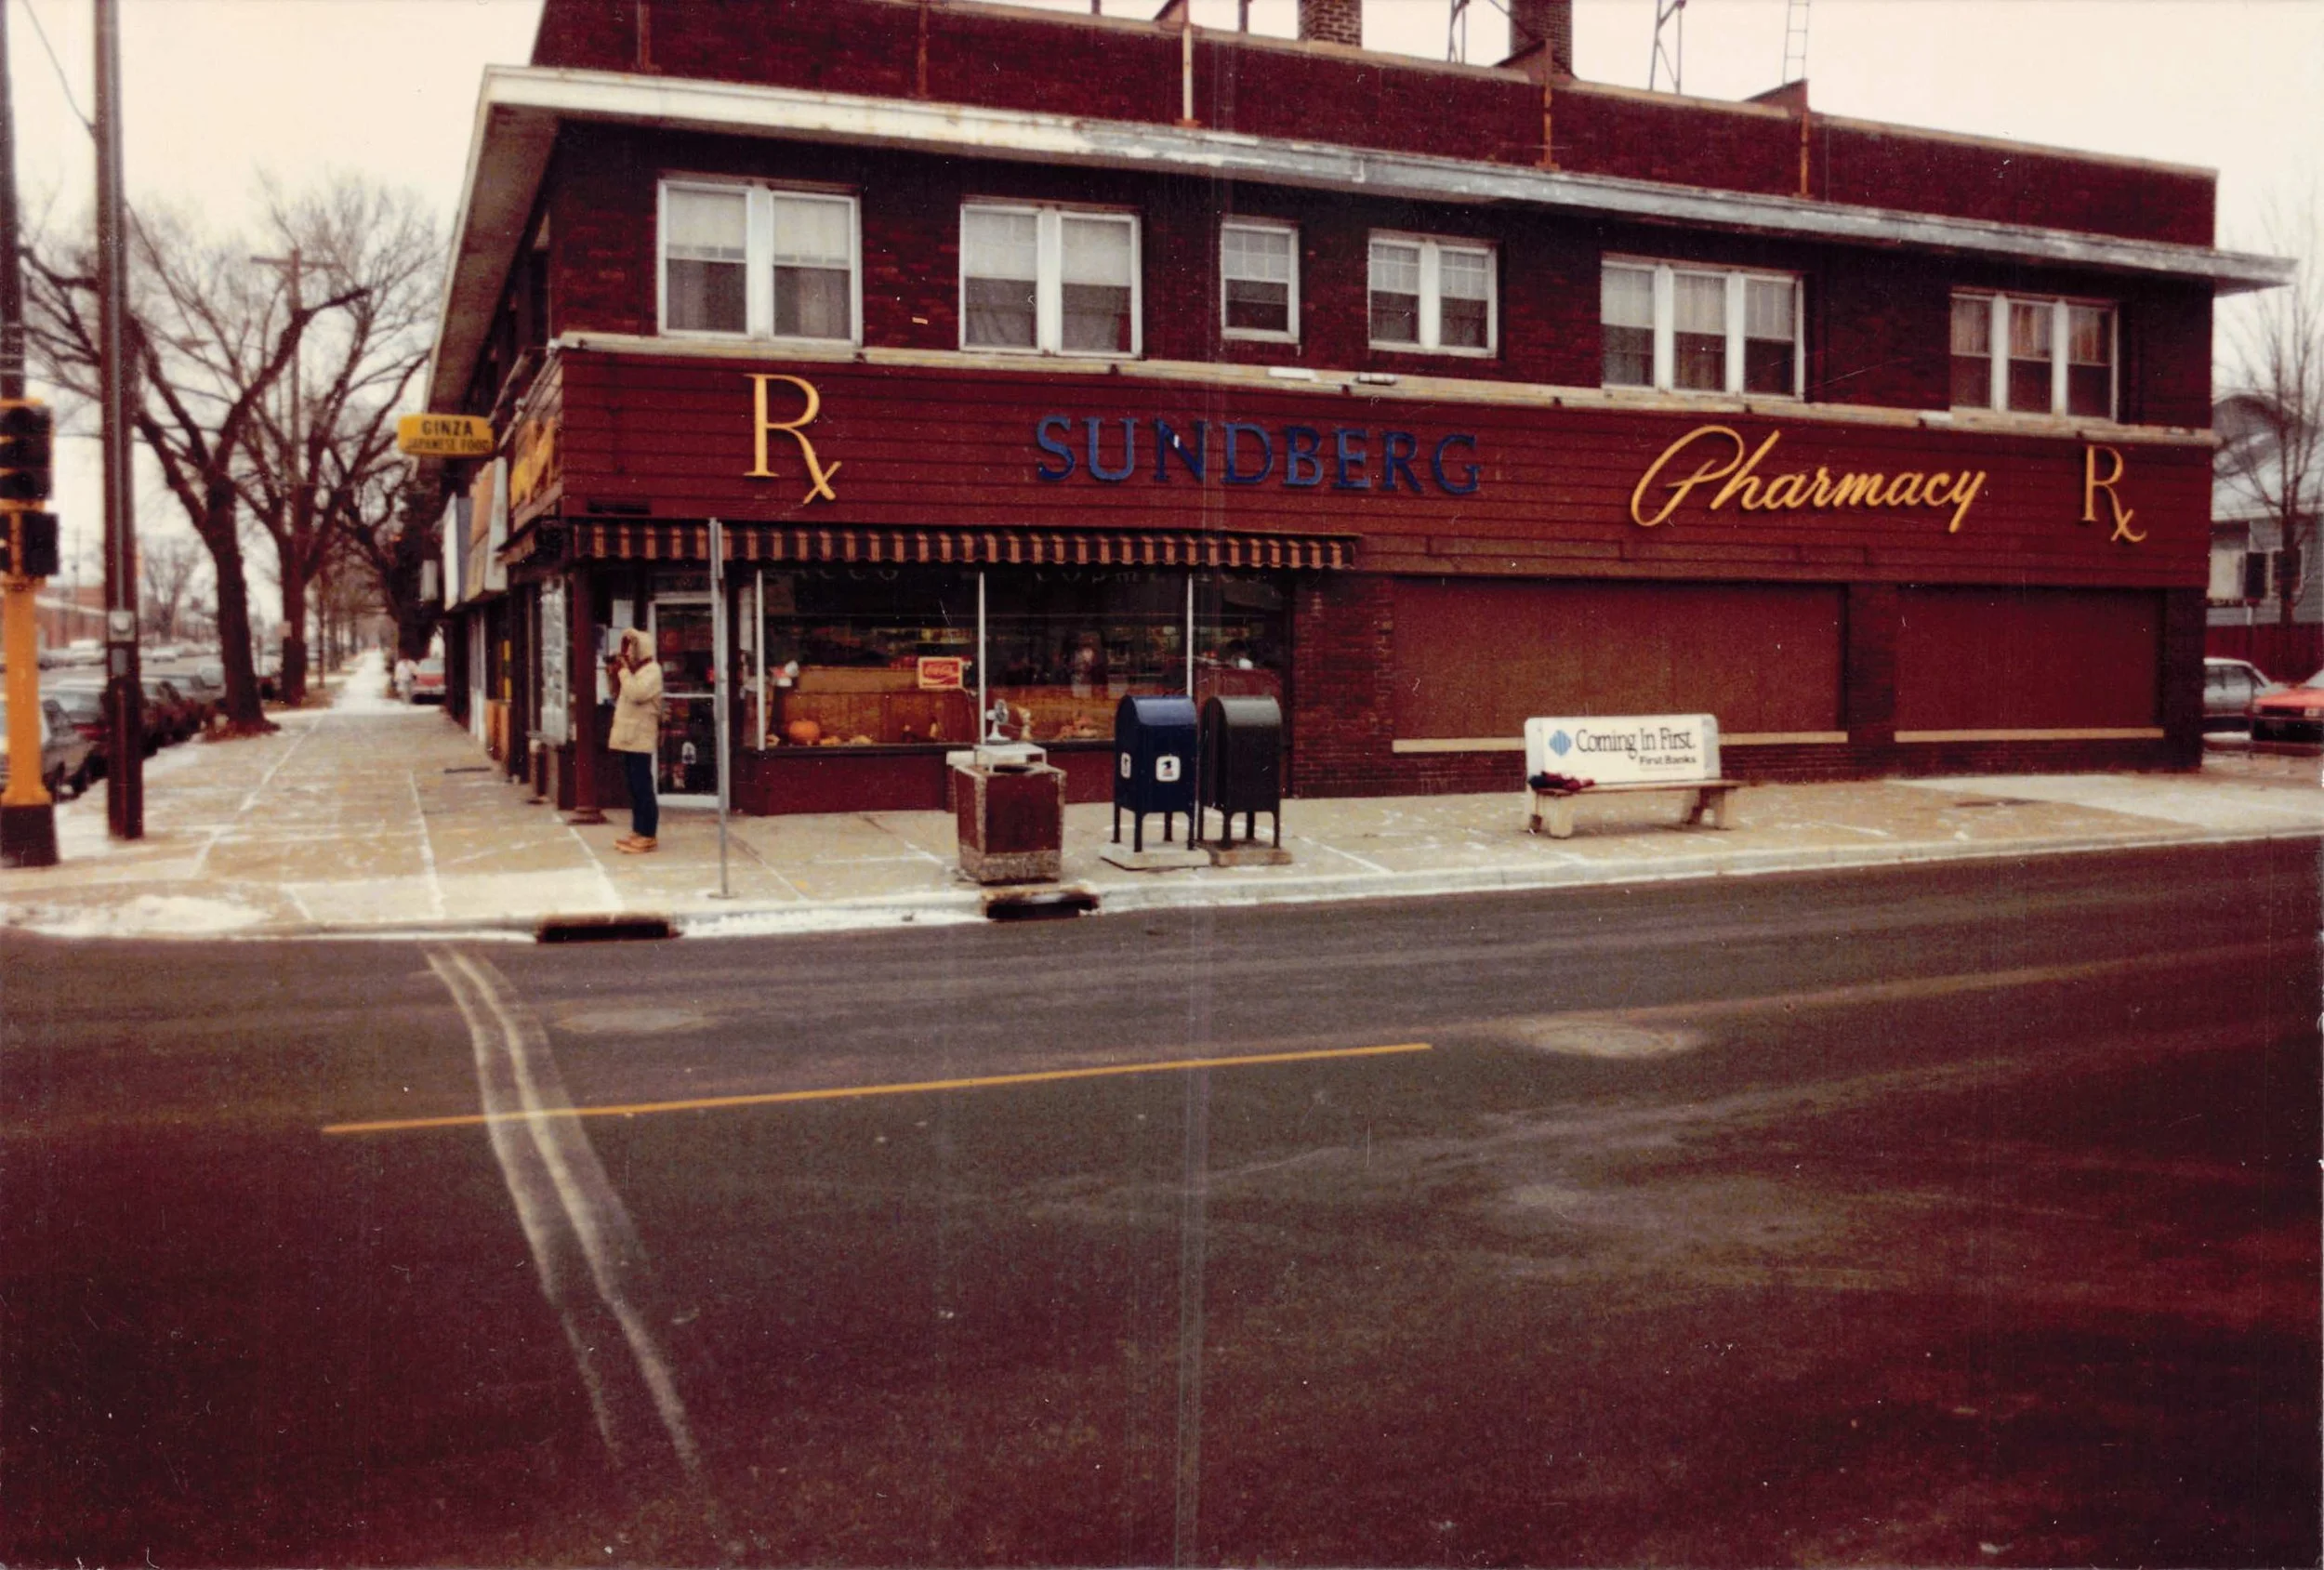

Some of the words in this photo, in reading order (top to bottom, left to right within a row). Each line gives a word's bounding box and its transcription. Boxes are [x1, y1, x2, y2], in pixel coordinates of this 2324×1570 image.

[422, 420, 474, 437] GINZA
[744, 373, 842, 505] Rx
[1037, 415, 1482, 495] SUNDBERG
[1630, 425, 1987, 533] Pharmacy
[2082, 444, 2147, 543] Rx
[1576, 729, 1638, 760] Coming
[1640, 727, 1657, 751] In
[1639, 756, 1663, 765] First
[1665, 755, 1697, 765] Banks
